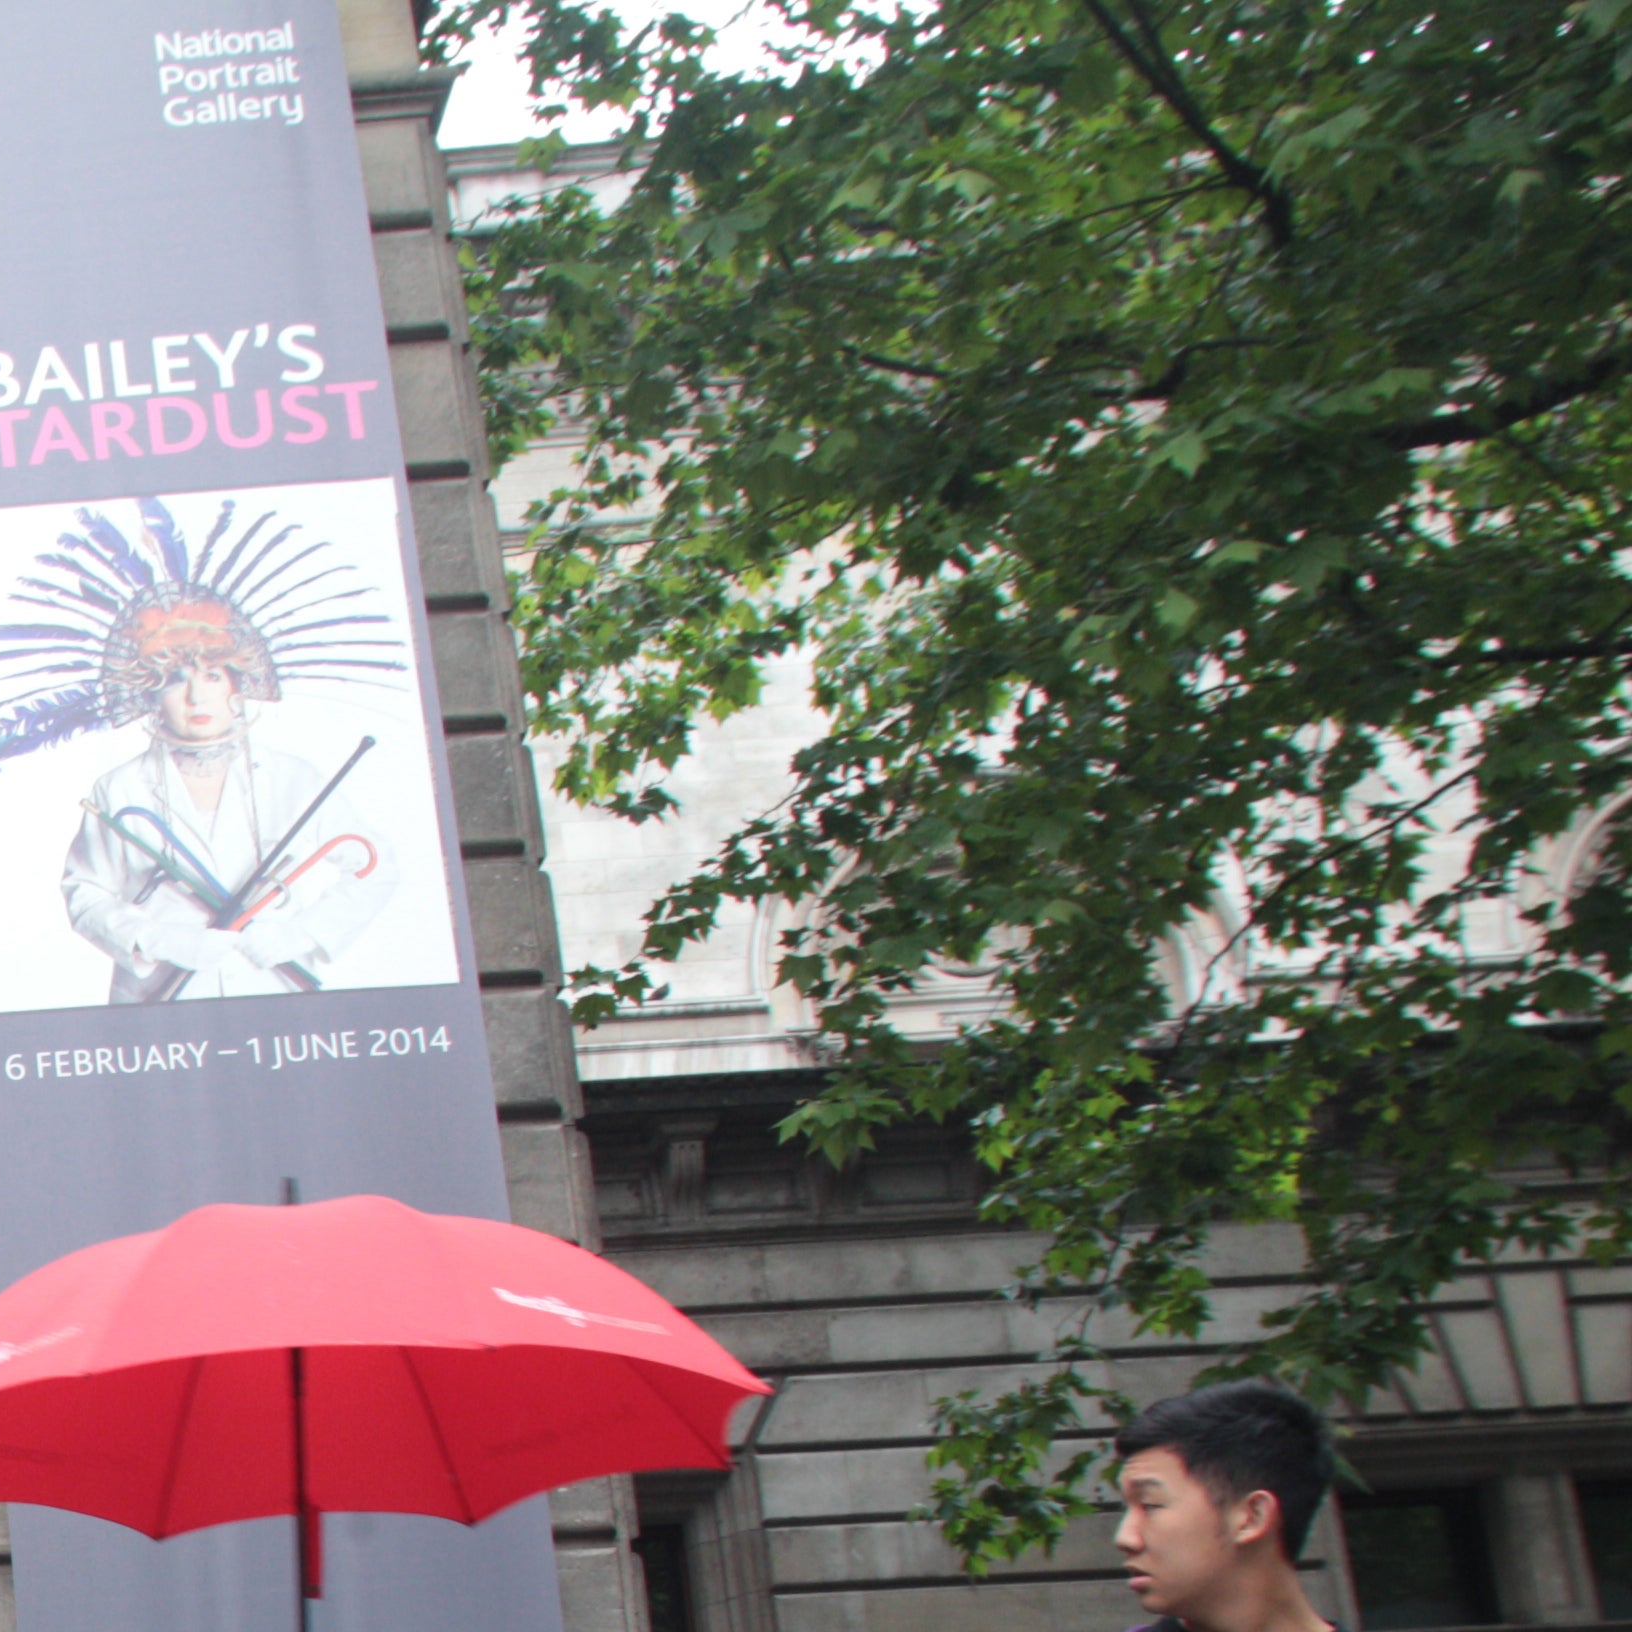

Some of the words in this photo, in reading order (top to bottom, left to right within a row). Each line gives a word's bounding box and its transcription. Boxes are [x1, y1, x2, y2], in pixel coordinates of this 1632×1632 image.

[155, 22, 295, 62] National
[159, 56, 301, 95] Portrait
[163, 91, 305, 127] Gallery
[4, 1053, 26, 1080] 6
[37, 1040, 208, 1079] FEBRUARY
[247, 1037, 262, 1065] 1
[270, 1031, 359, 1070] JUNE
[368, 1025, 452, 1058] 2014
